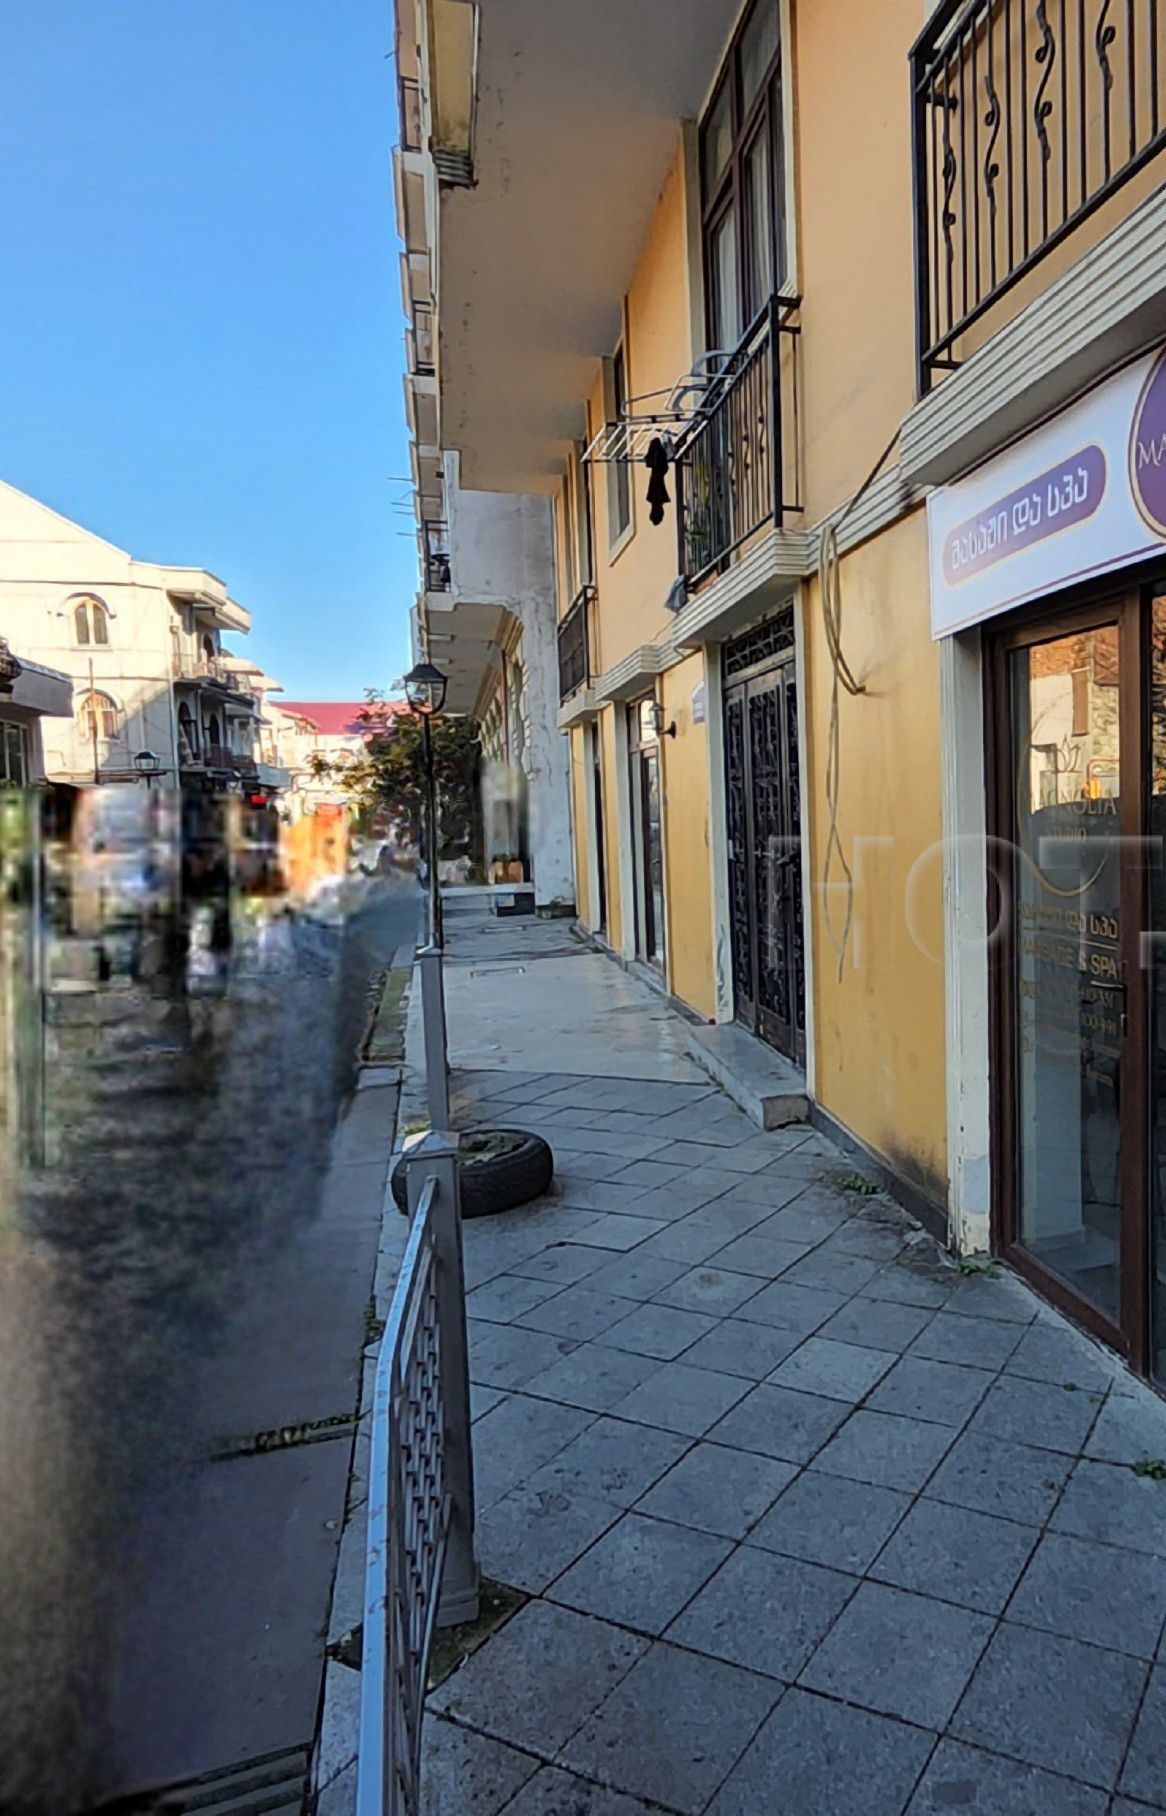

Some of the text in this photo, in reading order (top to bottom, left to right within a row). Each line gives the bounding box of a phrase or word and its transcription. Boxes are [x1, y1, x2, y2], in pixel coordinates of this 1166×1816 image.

[951, 466, 1089, 571] მასაჟი და სპა
[1090, 954, 1118, 980] SPA
